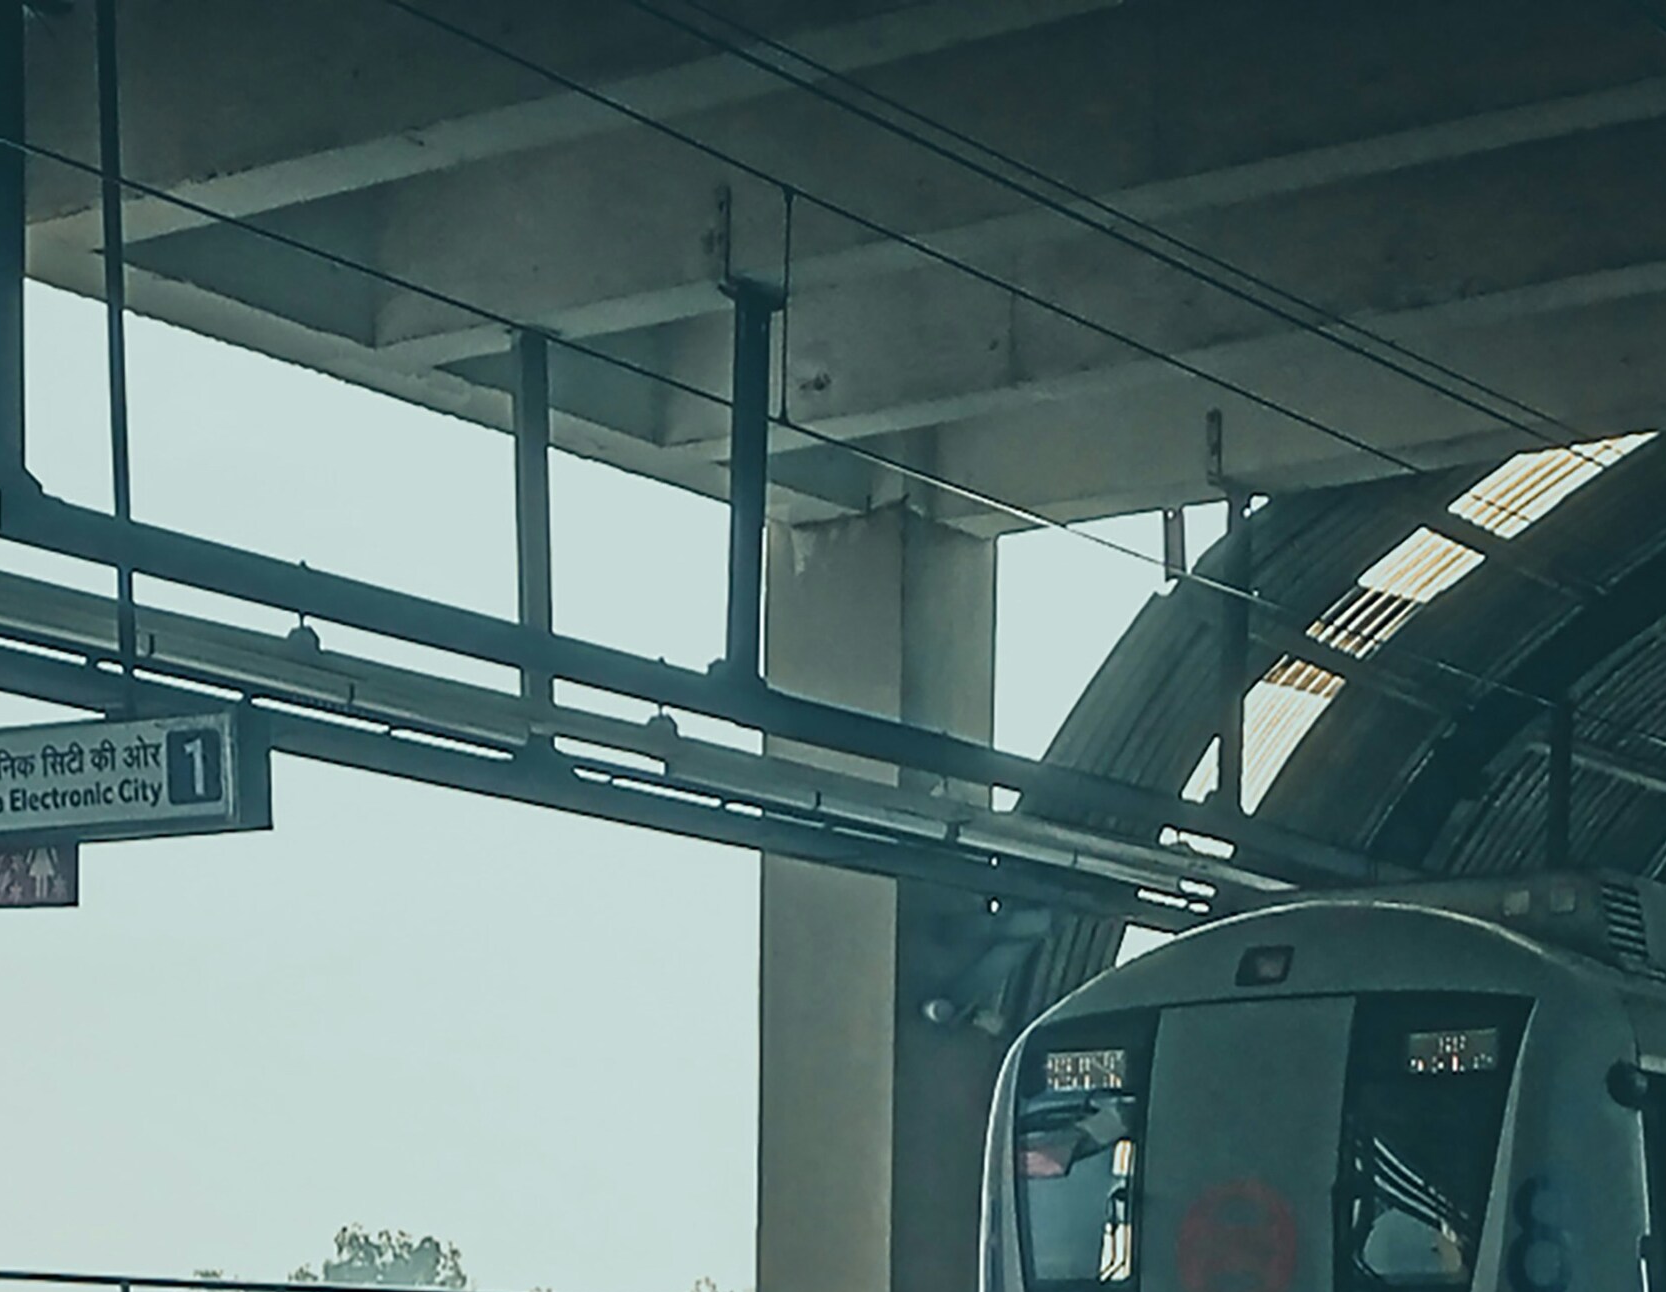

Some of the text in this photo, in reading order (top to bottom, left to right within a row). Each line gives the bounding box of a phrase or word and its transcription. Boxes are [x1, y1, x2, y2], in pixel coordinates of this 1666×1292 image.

[41, 742, 84, 777] सिटी
[90, 738, 116, 771] की
[122, 734, 162, 770] ओर
[184, 738, 205, 796] 1
[10, 782, 114, 813] Electronic
[118, 777, 163, 807] City
